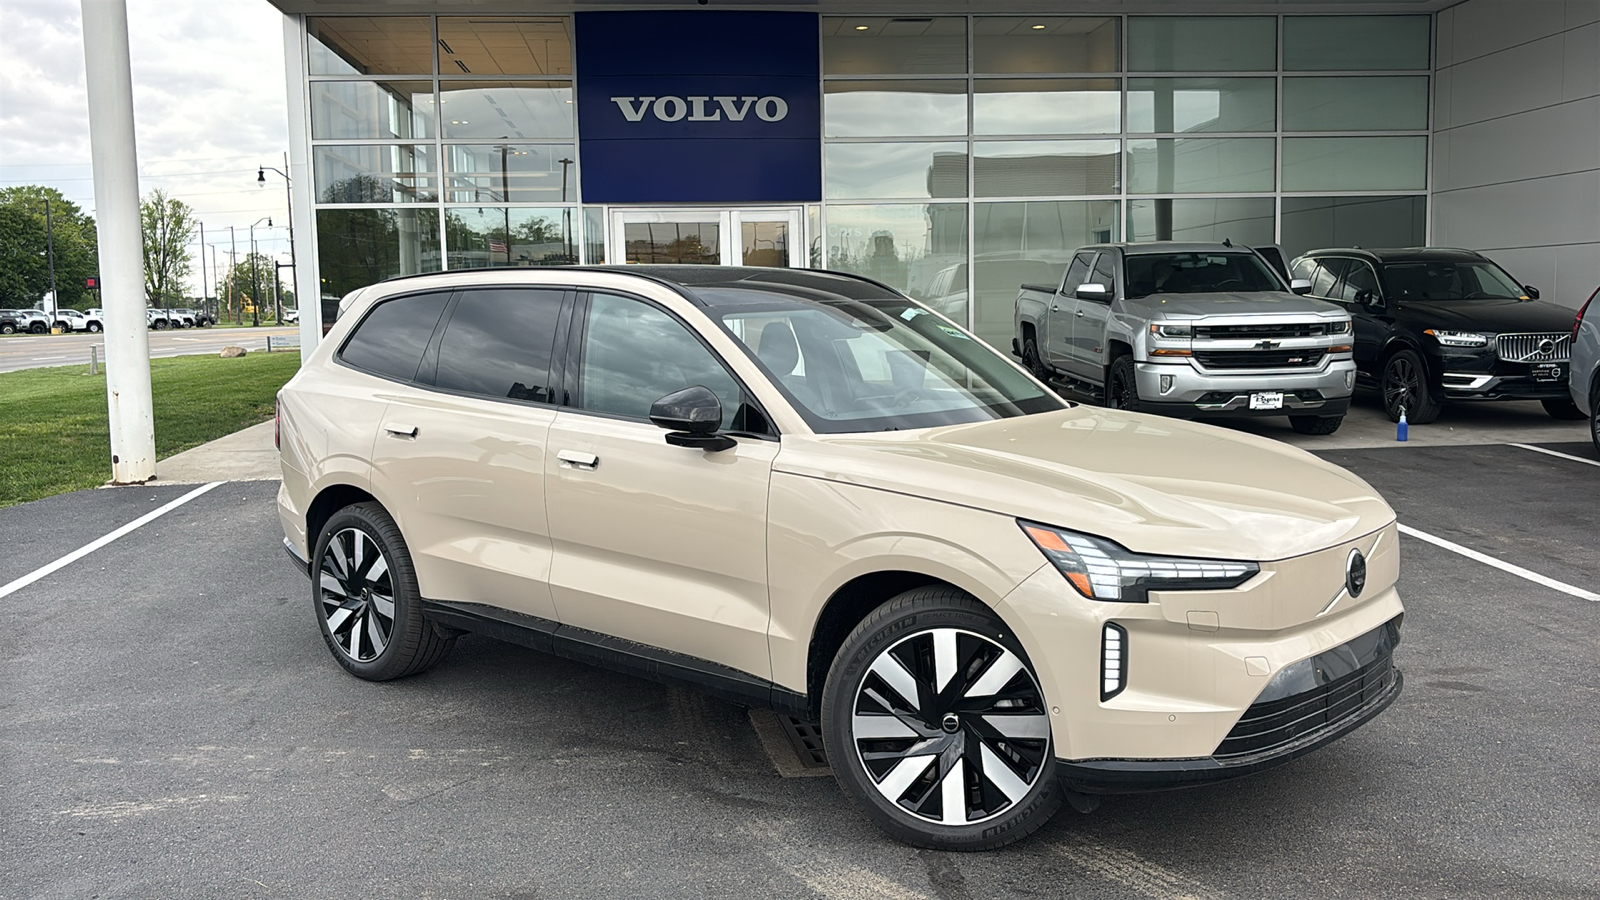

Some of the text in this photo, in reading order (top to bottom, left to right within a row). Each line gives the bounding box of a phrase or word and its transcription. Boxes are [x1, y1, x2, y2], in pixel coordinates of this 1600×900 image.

[610, 95, 789, 122] VOLVO
[857, 617, 914, 660] MICHELIN
[986, 794, 1044, 838] MICHELIN
